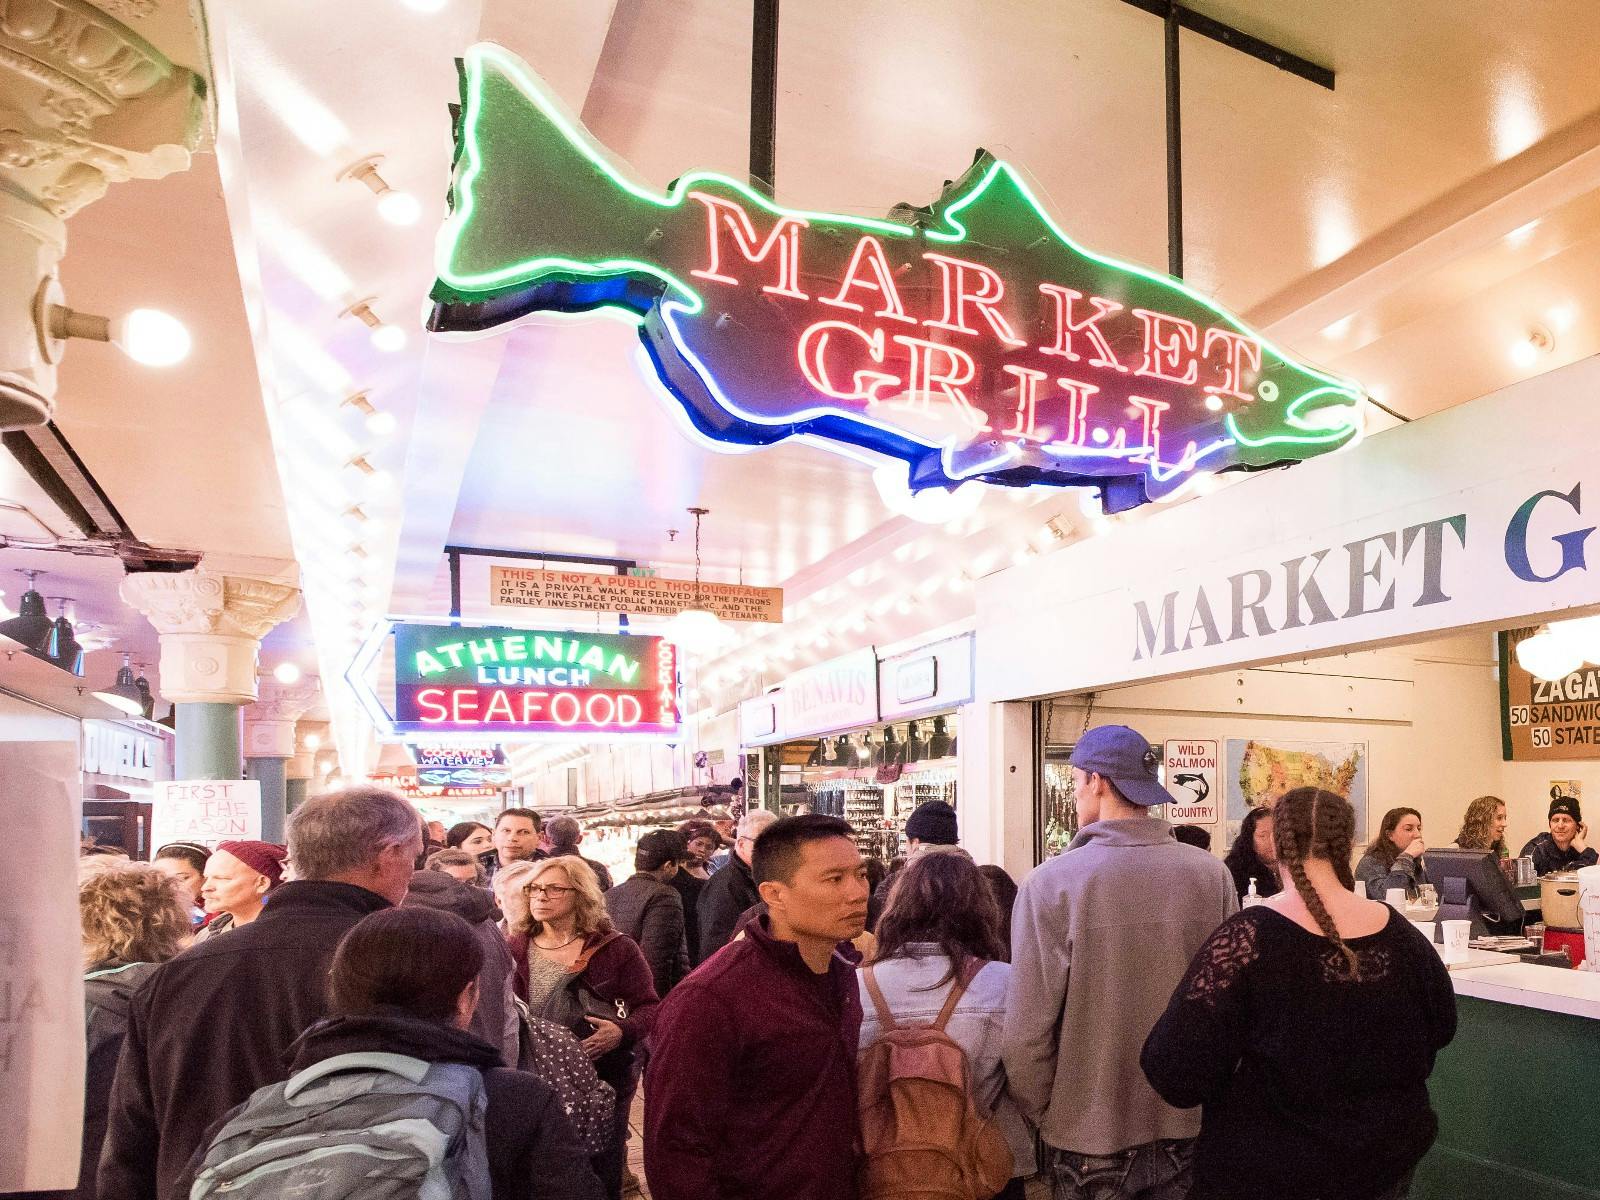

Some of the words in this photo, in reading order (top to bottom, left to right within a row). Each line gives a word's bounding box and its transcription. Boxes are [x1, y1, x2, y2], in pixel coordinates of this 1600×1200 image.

[684, 190, 1263, 400] MARKET
[797, 319, 1197, 470] GRILL
[501, 569, 534, 581] THIS
[542, 572, 554, 581] IS
[561, 574, 587, 584] NOT
[592, 576, 602, 585] A
[607, 577, 657, 589] PUBLIC
[664, 581, 769, 598] THOROUGHFARE
[1131, 514, 1467, 662] MARKET
[500, 588, 514, 596] OF
[520, 589, 540, 598] THE
[545, 591, 568, 600] PIKE
[573, 593, 606, 602] PLACE
[610, 595, 646, 605] PUBLIC
[722, 604, 740, 612] AND
[745, 605, 762, 613] THE
[545, 584, 593, 593] PRIVATE
[598, 587, 627, 595] WALK
[633, 590, 691, 600] RESERVED
[713, 595, 730, 603] THE
[733, 597, 771, 606] PATRONS
[501, 596, 542, 605] FAIRLEY
[547, 599, 610, 610] INVESTMENT
[635, 605, 653, 613] AND
[656, 606, 677, 614] THEIR
[730, 611, 768, 620] TENANTS
[415, 635, 639, 684] ATHENIAN
[477, 665, 591, 687] LUNCH
[658, 639, 676, 728] COCKTAILS
[417, 689, 642, 727] SEAFOOD
[1511, 707, 1528, 724] 50
[1533, 728, 1550, 747] 50
[1177, 745, 1205, 755] WILD
[421, 756, 463, 766] WATER
[467, 756, 496, 767] VIEW
[1168, 758, 1215, 768] SALMON
[166, 784, 234, 800] FIRST
[199, 801, 249, 818] THE
[1171, 807, 1214, 818] COUNTRY
[159, 818, 247, 833] SEASON
